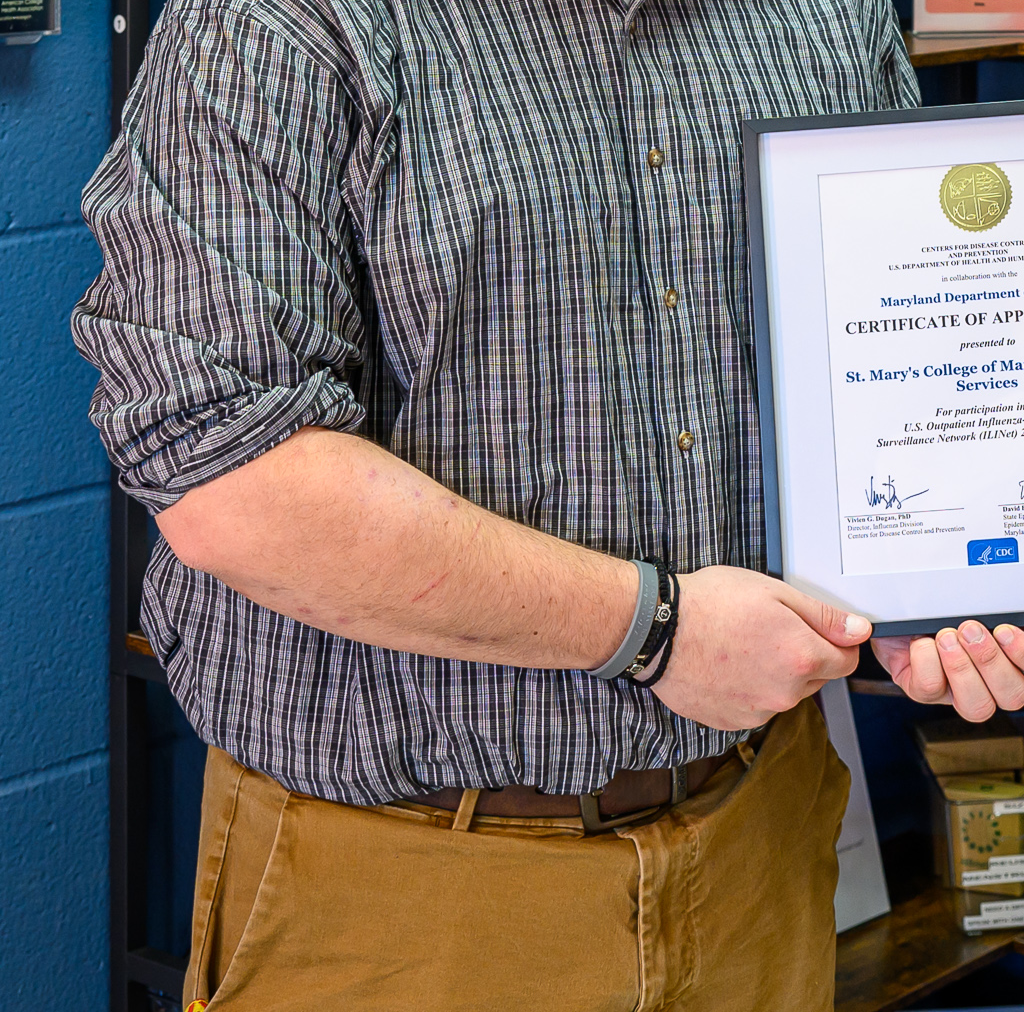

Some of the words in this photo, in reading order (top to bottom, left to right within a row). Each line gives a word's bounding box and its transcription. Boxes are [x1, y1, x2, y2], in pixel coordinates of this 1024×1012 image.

[964, 249, 1008, 258] PREVENTION
[902, 261, 949, 270] DEPARTMENT
[949, 273, 991, 282] collaboration
[880, 293, 941, 308] Maryland
[944, 289, 1020, 304] Department
[845, 314, 960, 335] CERTIFICATE
[965, 312, 987, 326] OF
[959, 337, 1005, 352] presented
[1007, 338, 1016, 346] to
[846, 371, 865, 383] St.
[870, 366, 920, 382] Mary's
[923, 363, 978, 378] College
[981, 360, 997, 373] of
[956, 377, 1018, 392] Services
[935, 407, 953, 417] For
[954, 403, 1014, 417] participation
[904, 422, 923, 432] U.S.
[926, 419, 976, 432] Outpatient
[876, 436, 935, 448] Surveillance
[937, 432, 976, 443] Network
[979, 429, 1018, 441] (ILINet)
[901, 528, 923, 536] Control
[996, 547, 1013, 556] CDC
